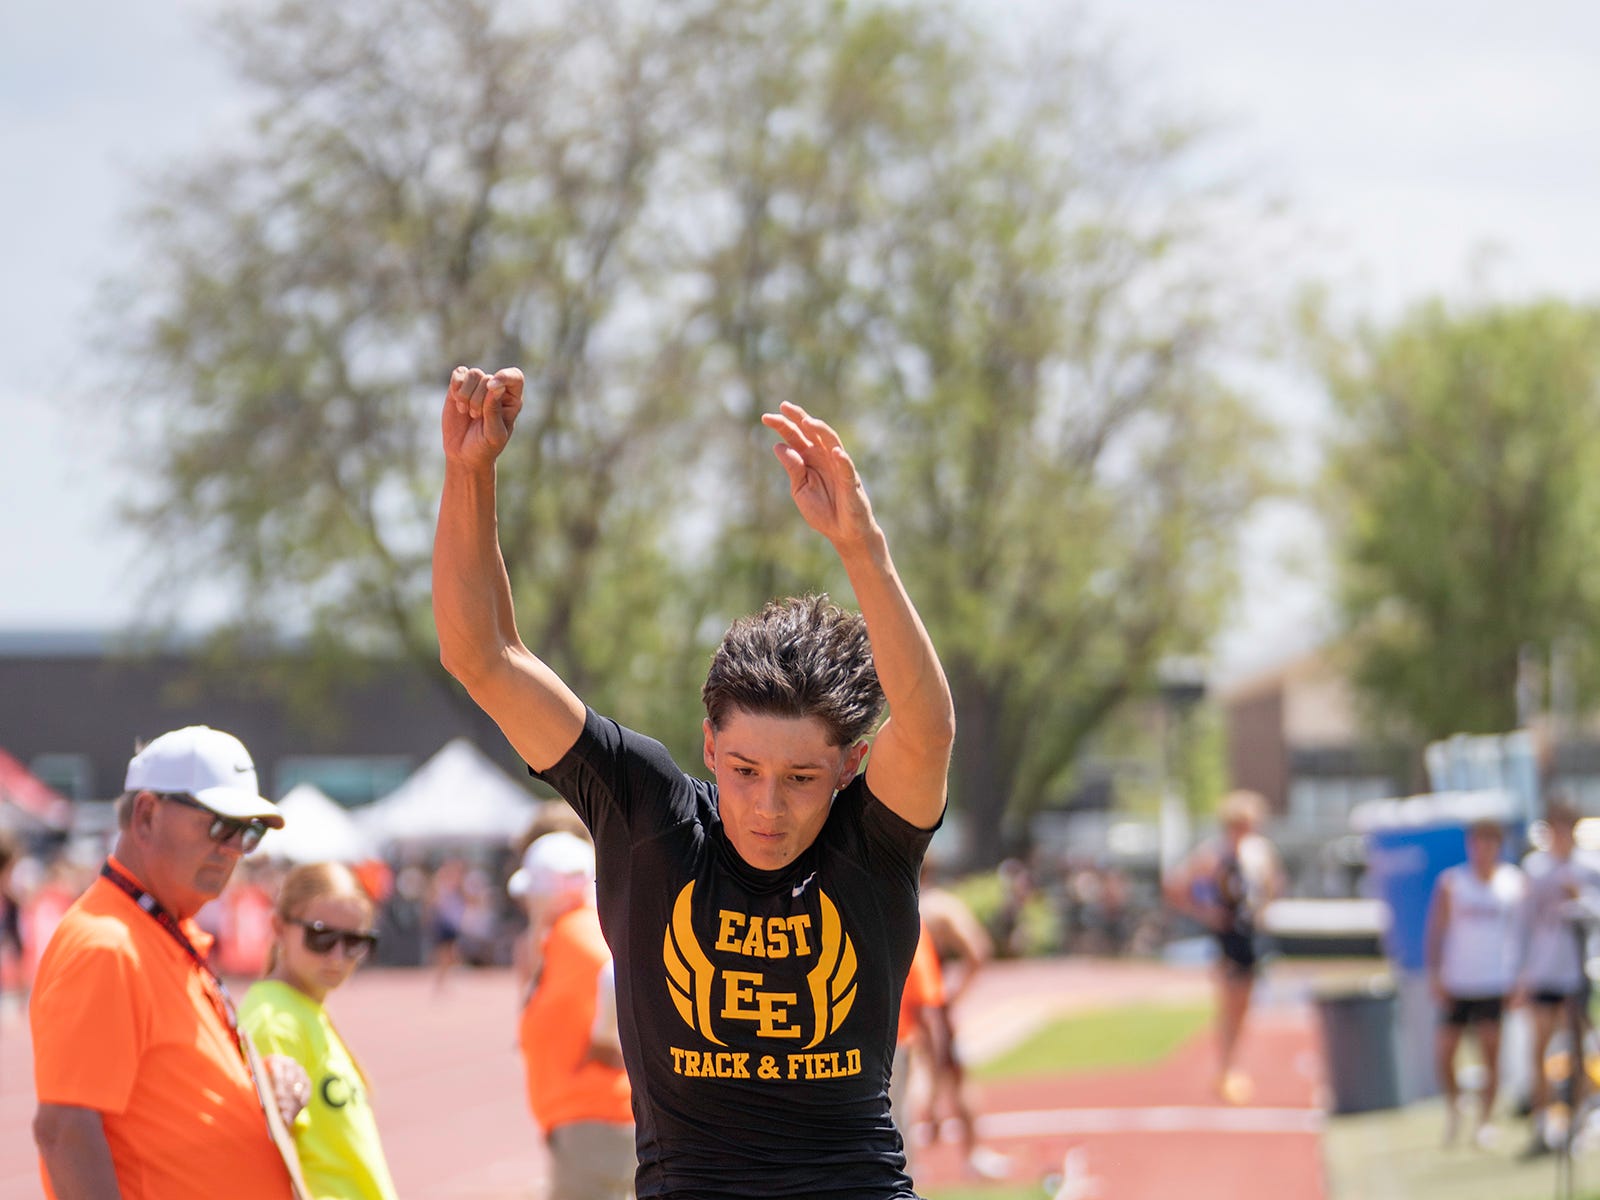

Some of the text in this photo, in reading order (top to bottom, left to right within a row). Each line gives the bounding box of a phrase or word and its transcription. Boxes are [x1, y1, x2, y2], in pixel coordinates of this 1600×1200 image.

[715, 909, 812, 959] EAST
[670, 1046, 862, 1080] TRACK & FIELD
